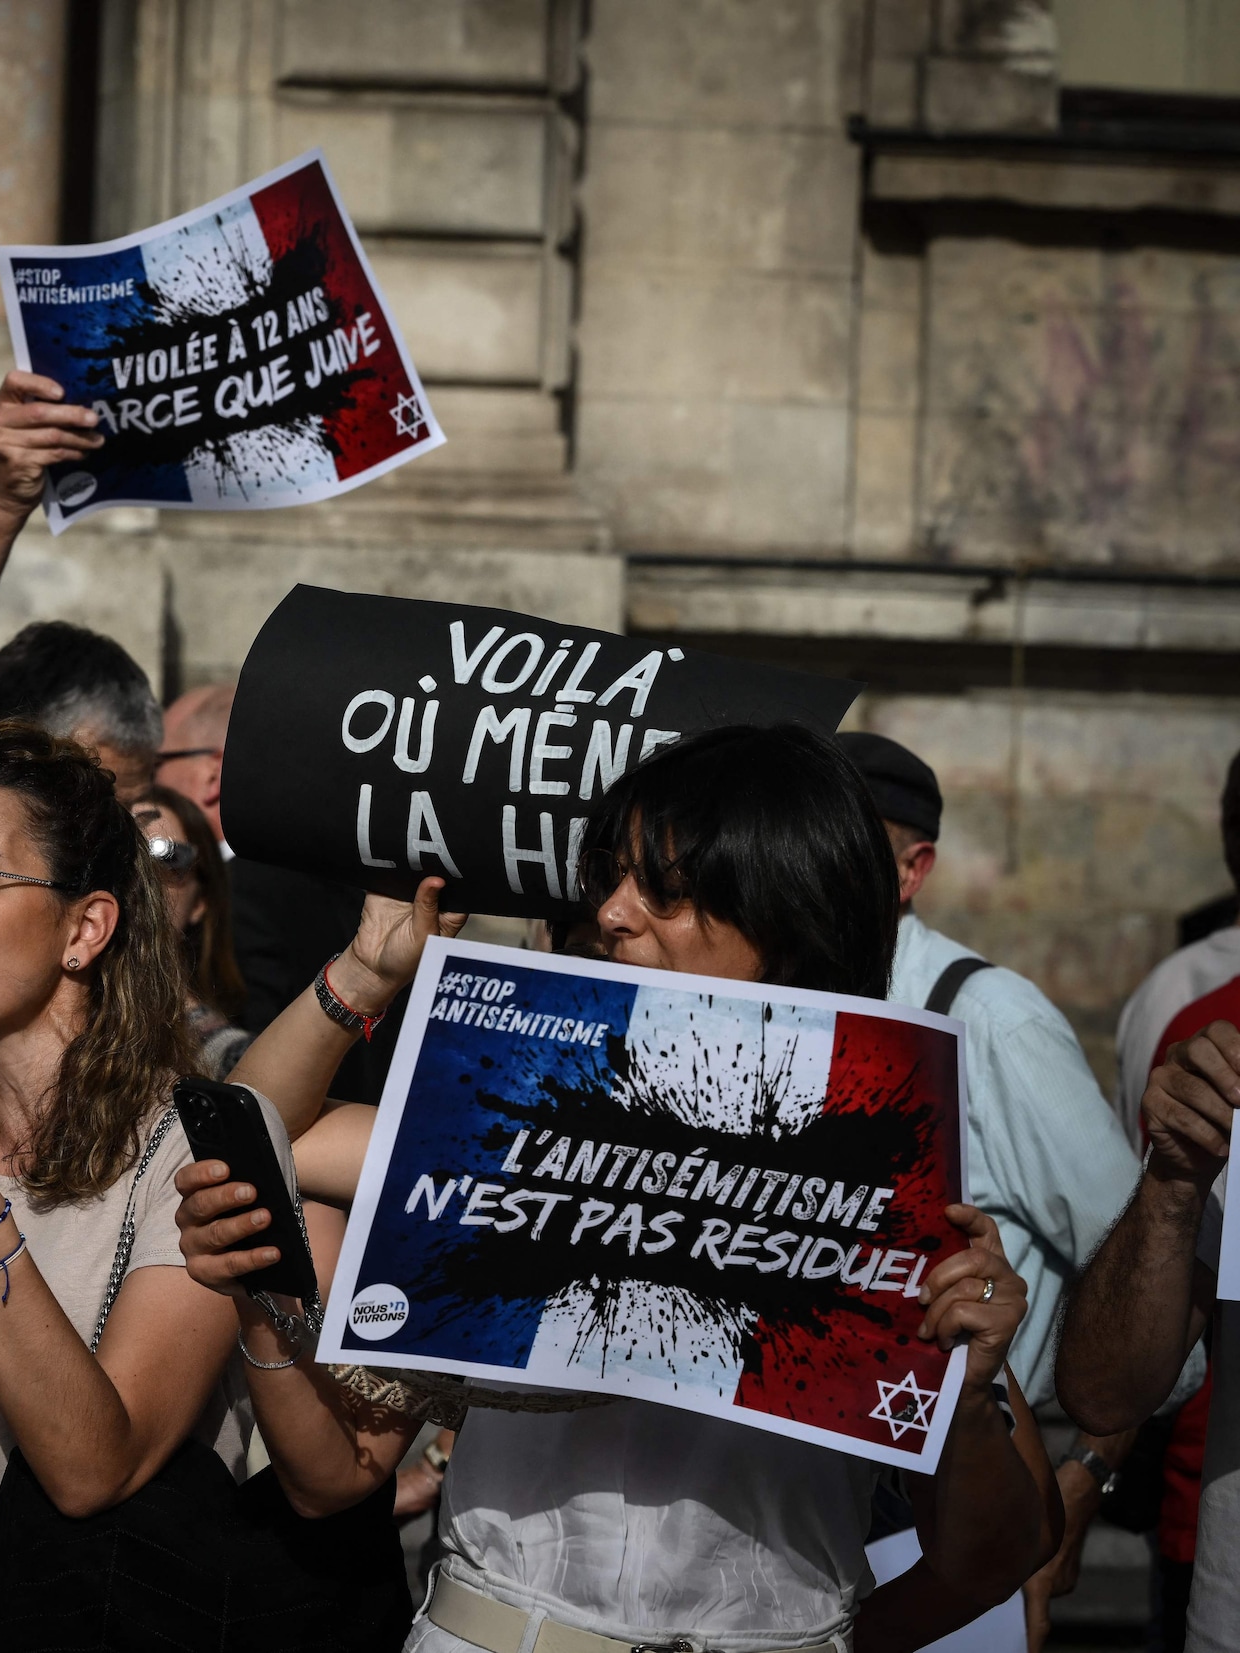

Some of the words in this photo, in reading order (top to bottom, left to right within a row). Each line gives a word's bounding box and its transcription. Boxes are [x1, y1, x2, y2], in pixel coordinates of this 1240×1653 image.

[15, 267, 62, 286] #STOP
[18, 278, 134, 304] ANTISÉMITISME
[91, 386, 202, 434] ARCE
[214, 354, 296, 418] QUE
[304, 312, 381, 389] JUIVE
[112, 331, 218, 389] VIOLÉE
[227, 318, 248, 363] À
[251, 310, 283, 351] 12
[286, 286, 330, 338] ANS
[341, 674, 440, 774] OÙ
[356, 783, 464, 879] LA
[429, 997, 610, 1047] ANTISÉMITISME
[437, 971, 516, 1003] #STOP
[500, 1129, 895, 1231] L'ANTISÉMITISME
[404, 1173, 572, 1242] N'EST
[570, 1197, 686, 1257] PAS
[690, 1212, 928, 1299] RÉSIDUEL
[353, 1304, 388, 1315] NOUS
[353, 1312, 405, 1324] VIVRONS
